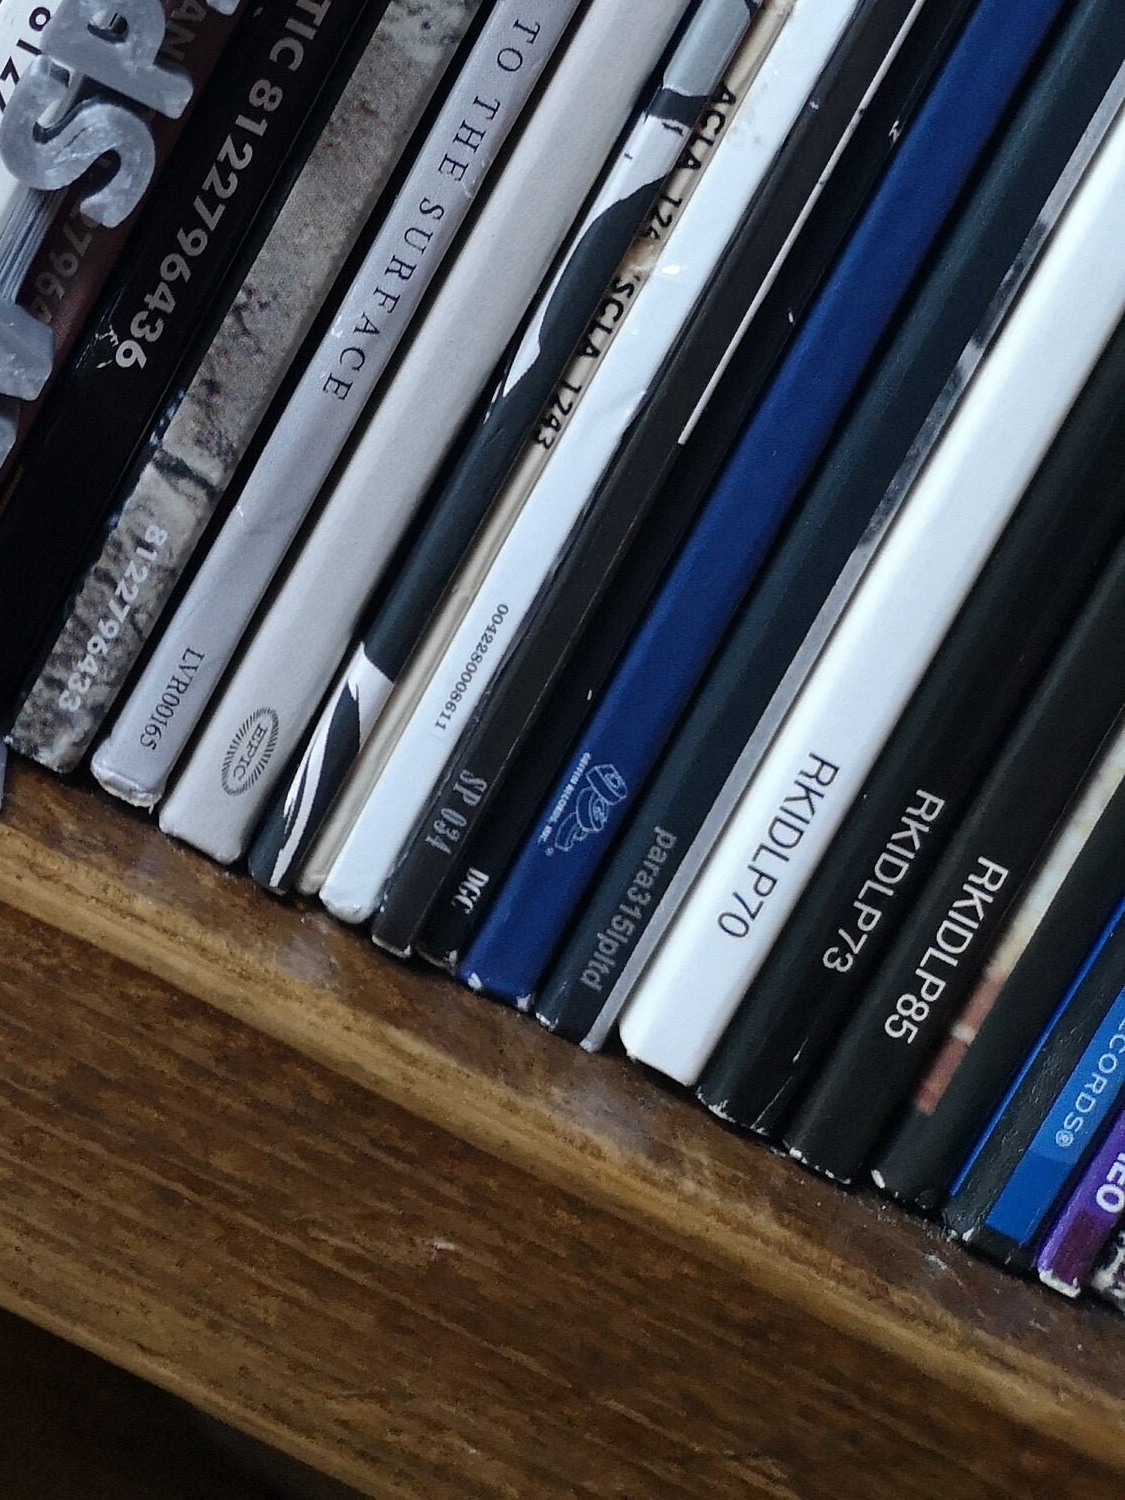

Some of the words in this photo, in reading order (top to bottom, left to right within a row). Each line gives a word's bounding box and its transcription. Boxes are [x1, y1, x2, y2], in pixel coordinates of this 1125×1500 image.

[489, 13, 542, 80] TO
[434, 89, 501, 184] THE
[674, 83, 740, 177] ACLA
[107, 75, 286, 376] 8122796436
[316, 194, 446, 405] SURFACE
[527, 376, 583, 451] 1243
[52, 522, 170, 716] 8122796433
[430, 601, 510, 732] 0042280008611
[134, 644, 205, 752] LVR00165
[227, 721, 270, 782] EPIC
[448, 767, 488, 807] SP
[422, 805, 468, 856] 034
[712, 751, 839, 942] RKIDLP70
[448, 865, 490, 914] DGC
[817, 787, 944, 977] RKIDLP73
[879, 854, 1008, 1046] RKIDLP85
